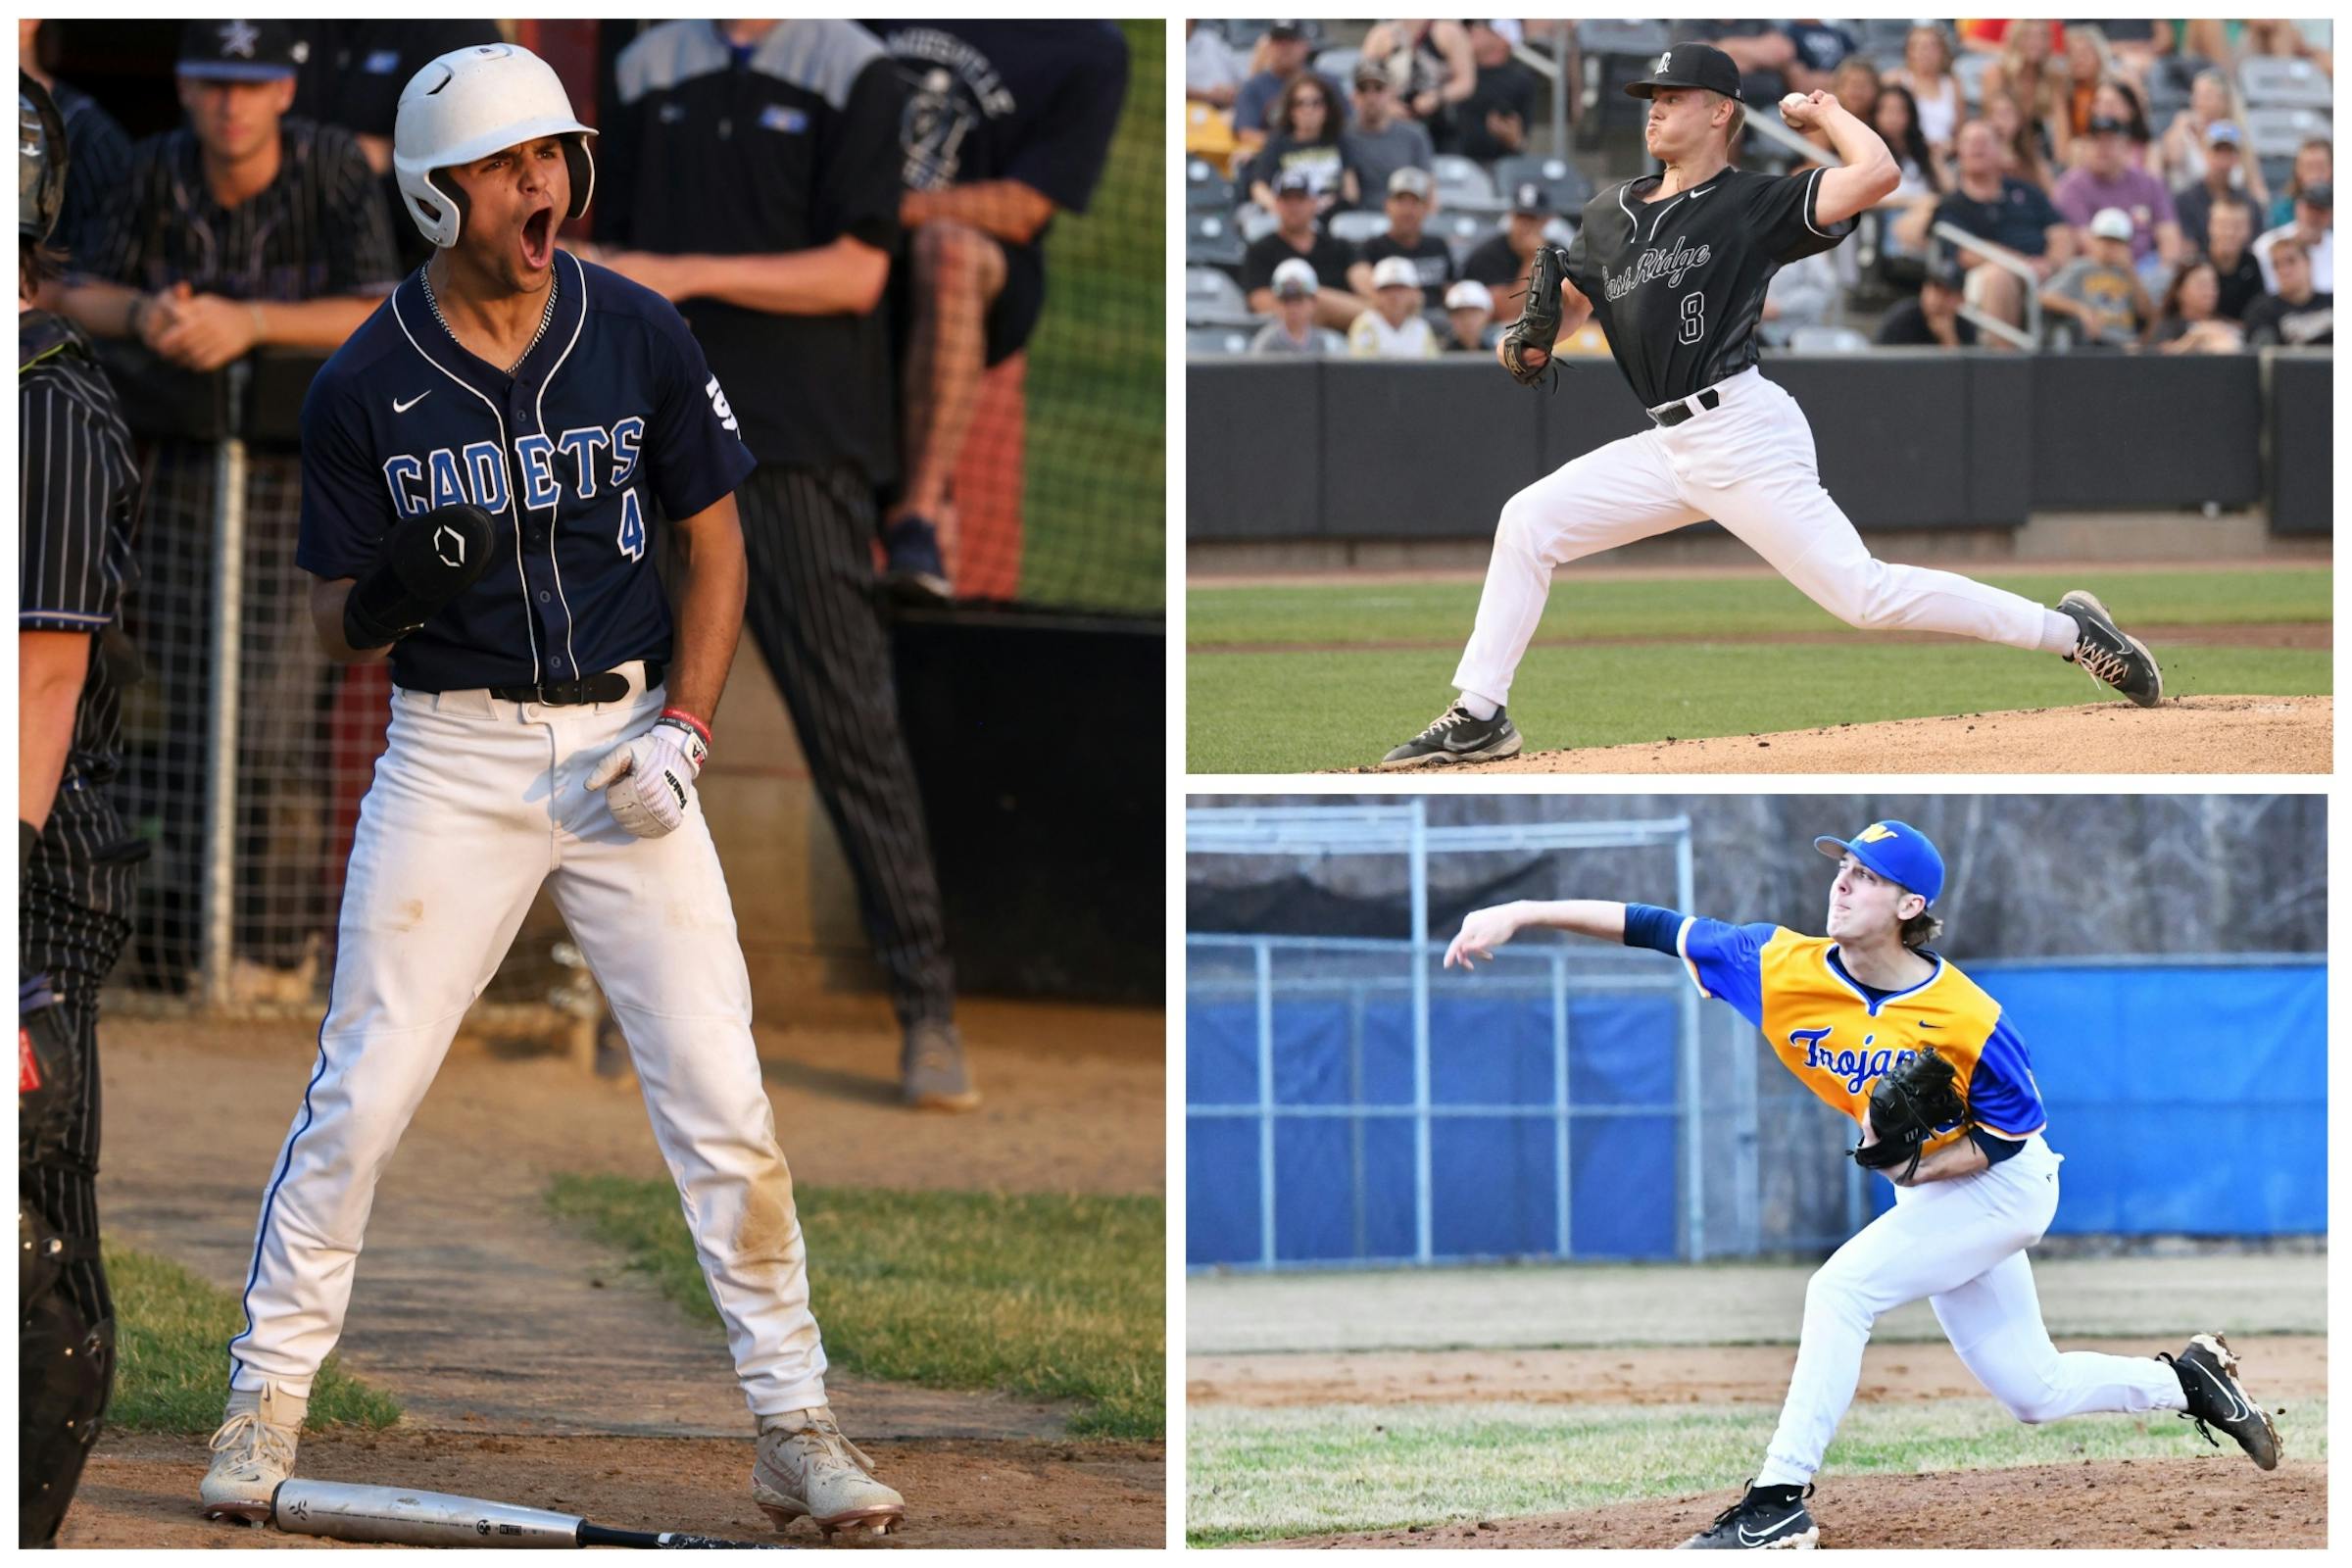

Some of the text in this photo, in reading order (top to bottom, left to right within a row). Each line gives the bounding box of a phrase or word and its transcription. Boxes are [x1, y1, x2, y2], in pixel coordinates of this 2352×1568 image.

[1631, 235, 1711, 288] Ridge
[1679, 291, 1705, 345] 8
[383, 416, 646, 519] CADETS
[617, 488, 646, 564] 4
